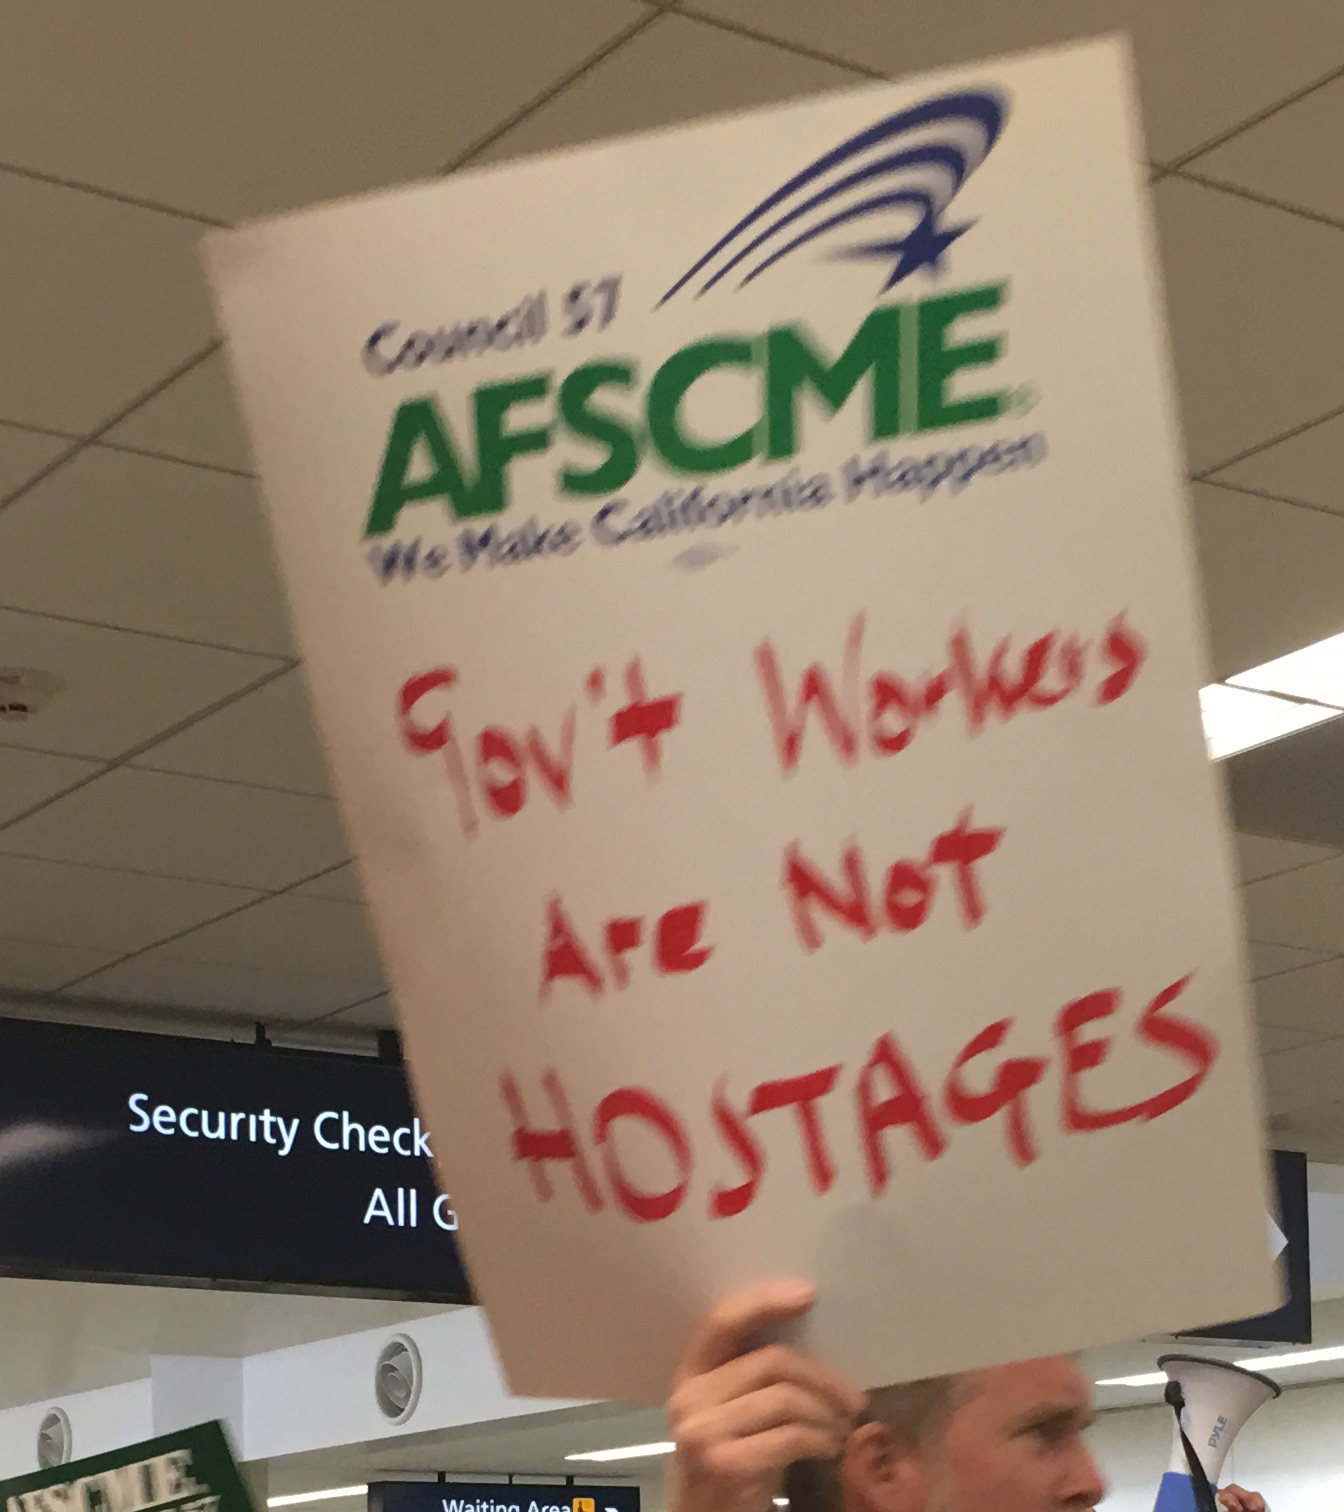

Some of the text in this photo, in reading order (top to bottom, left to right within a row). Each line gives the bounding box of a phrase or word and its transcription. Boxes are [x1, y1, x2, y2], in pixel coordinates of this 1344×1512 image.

[361, 273, 623, 379] Council 57
[362, 279, 1012, 539] AFSCME
[365, 431, 1048, 586] We Make California Happen
[395, 608, 1147, 836] Gov't Workers
[782, 803, 1008, 954] Not
[128, 1092, 435, 1159] Security Check
[501, 969, 1224, 1223] HOSTAGES
[363, 1187, 417, 1228] All
